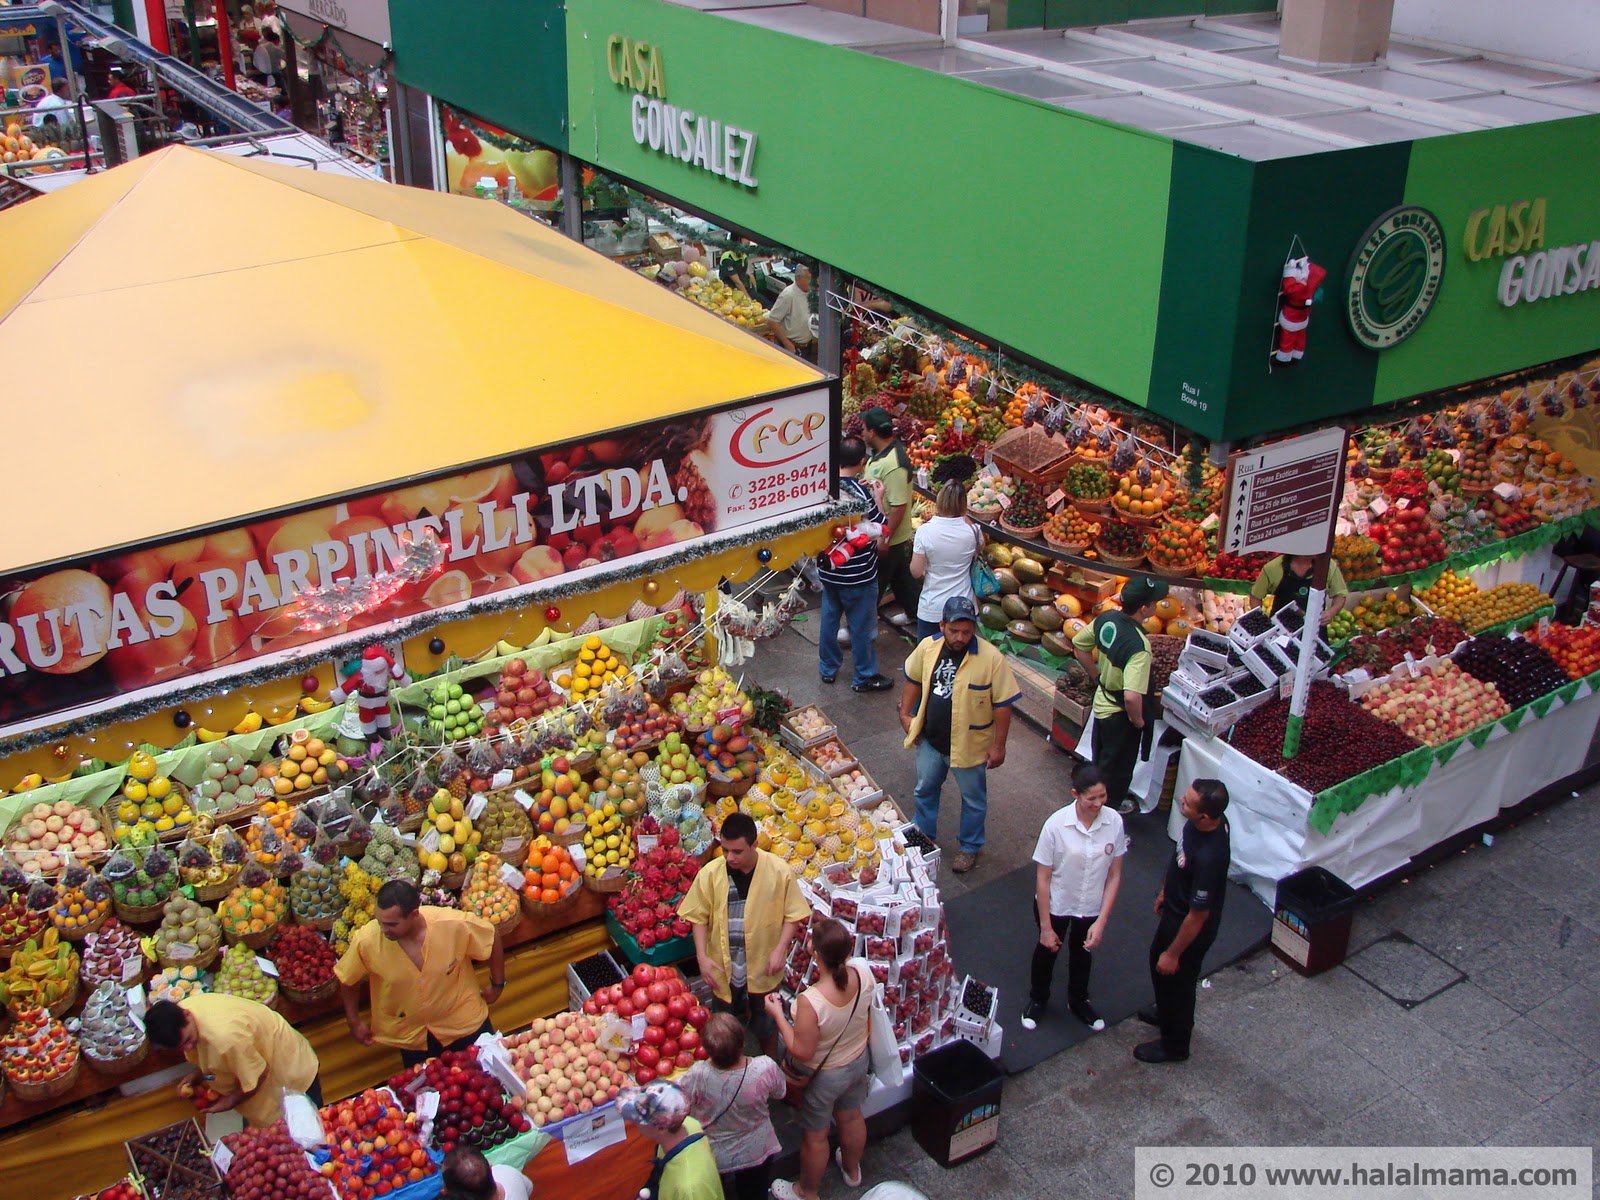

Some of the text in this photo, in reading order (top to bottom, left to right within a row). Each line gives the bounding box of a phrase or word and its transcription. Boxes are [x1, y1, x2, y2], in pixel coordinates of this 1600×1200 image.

[607, 33, 667, 98] CASA
[632, 93, 758, 187] GONSALEZ
[1463, 197, 1547, 262] CASA
[1497, 240, 1600, 307] GONSA
[1182, 381, 1196, 395] Rua
[1180, 392, 1208, 412] Boxe 19
[748, 461, 828, 494] 3228-9474
[1237, 463, 1254, 475] Rua
[1256, 467, 1299, 486] Frutas Exóticas
[727, 478, 827, 514] Fax: 3228-6014
[1252, 494, 1298, 513] Rua 25 de Março
[1250, 518, 1262, 529] Rua
[1263, 515, 1270, 525] da
[1270, 507, 1299, 523] Cantareira
[1248, 525, 1289, 543] Caixa 24 horas
[0, 580, 185, 678] RUTAS
[548, 457, 688, 536] LTDA.
